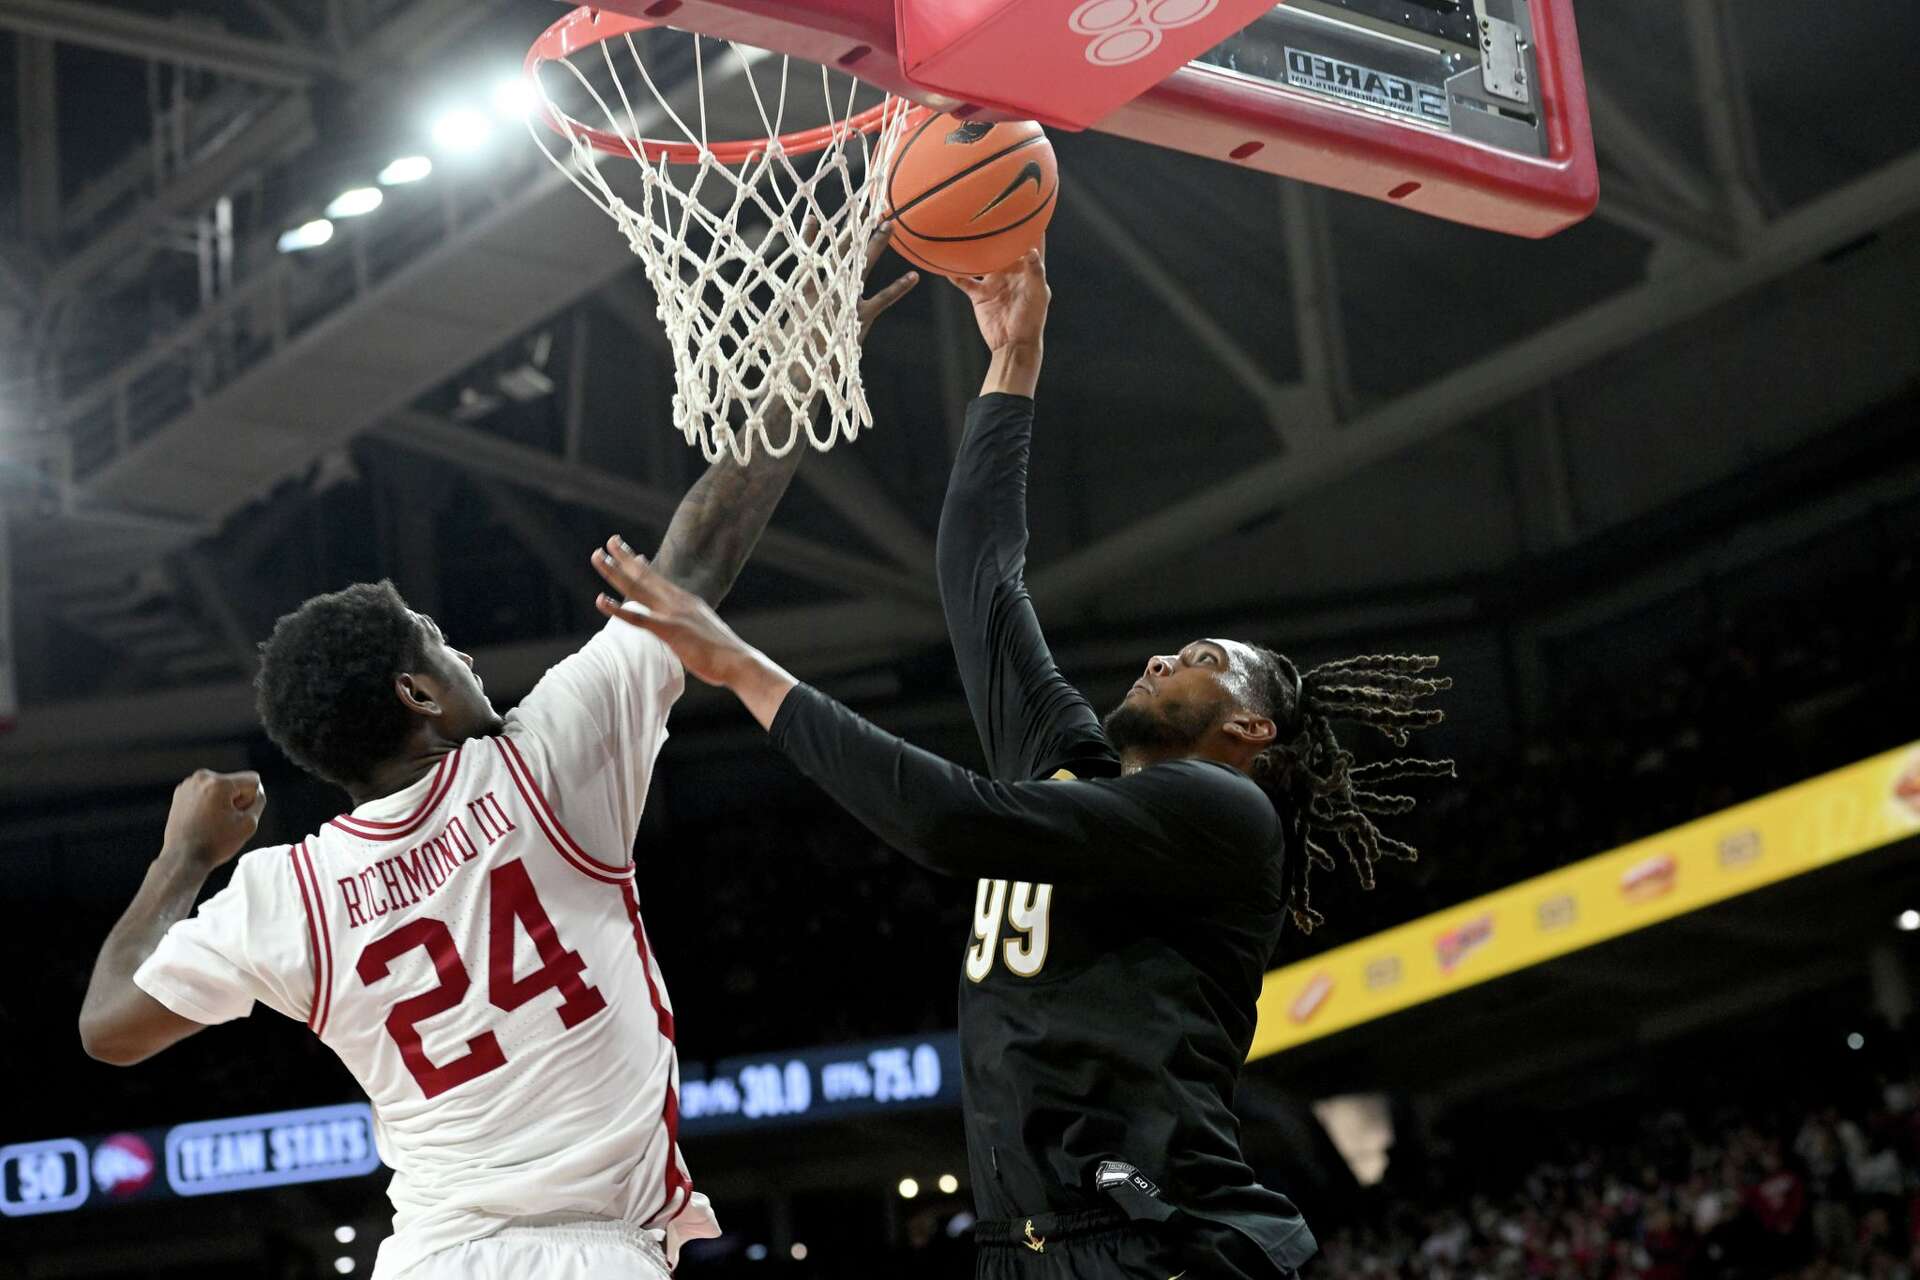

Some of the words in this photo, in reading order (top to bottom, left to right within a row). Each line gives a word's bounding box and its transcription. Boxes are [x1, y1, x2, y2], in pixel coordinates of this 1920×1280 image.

[337, 816, 478, 929] RICHMOND
[467, 792, 517, 845] III
[355, 857, 608, 1100] 24
[966, 878, 1053, 983] 99
[180, 1131, 265, 1182] TEAM
[269, 1116, 367, 1172] STATS
